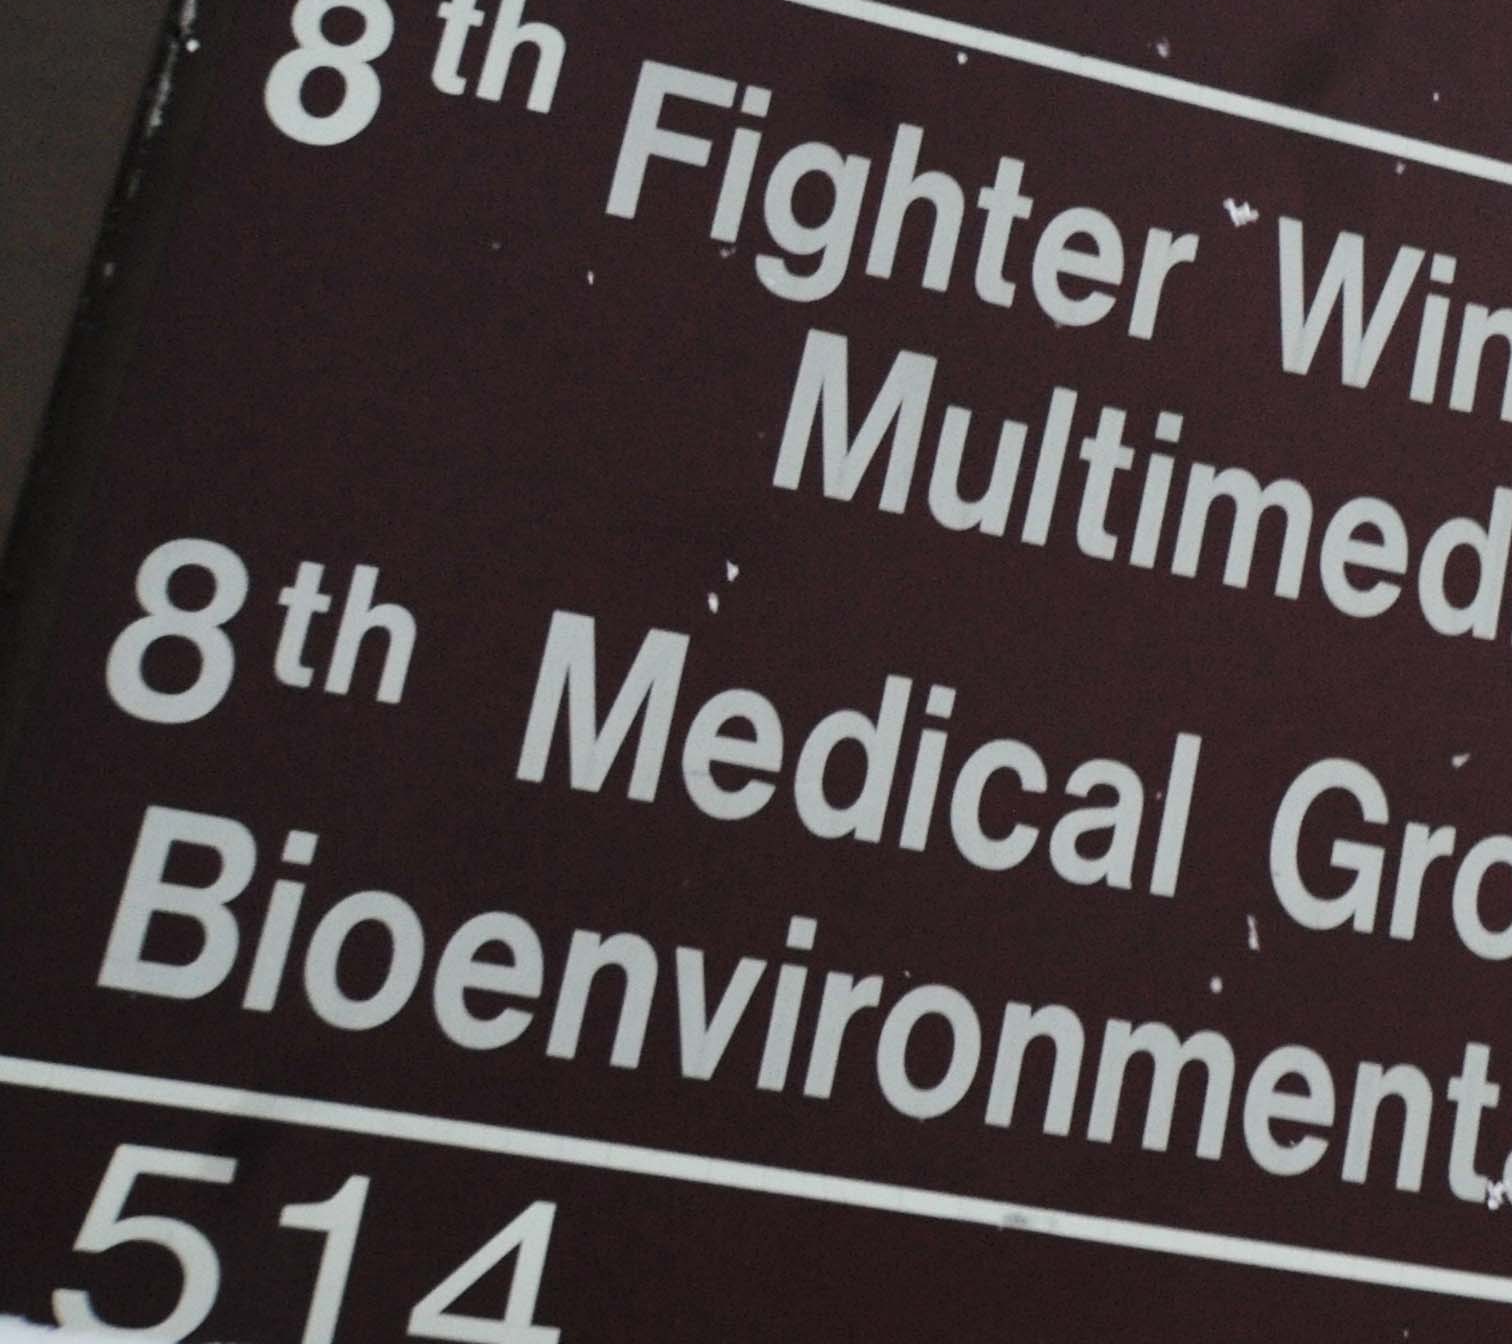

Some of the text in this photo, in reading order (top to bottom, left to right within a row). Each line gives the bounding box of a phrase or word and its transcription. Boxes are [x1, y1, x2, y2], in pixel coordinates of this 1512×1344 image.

[606, 61, 1200, 340] Fighter
[107, 539, 416, 724] 8th
[517, 611, 1201, 897] Medical
